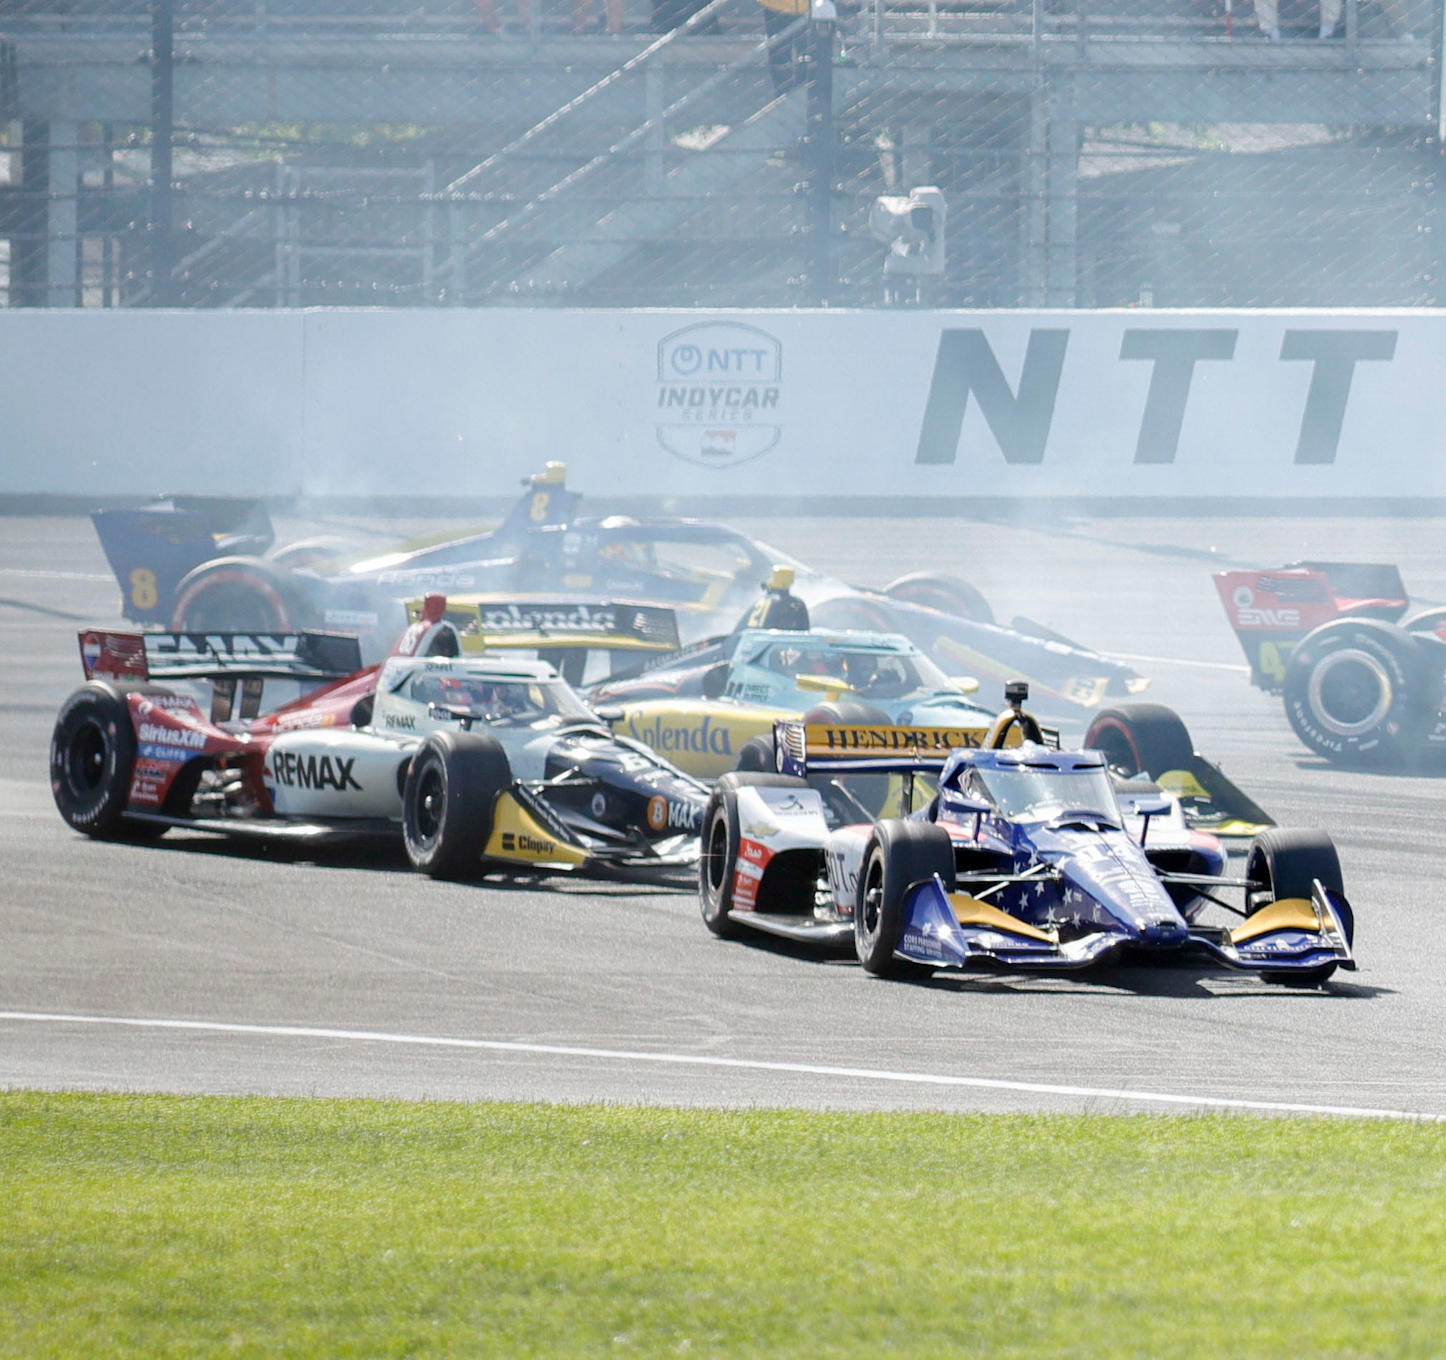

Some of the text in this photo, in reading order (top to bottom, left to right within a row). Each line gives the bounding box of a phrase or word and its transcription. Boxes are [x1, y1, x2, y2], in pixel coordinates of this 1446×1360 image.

[707, 349, 768, 372] NTT
[657, 387, 780, 409] INDYCAR
[915, 327, 1399, 465] NTT
[530, 492, 550, 523] 8
[130, 567, 158, 610] 8
[747, 597, 771, 629] 21
[138, 722, 208, 750] SiriusXM
[627, 708, 734, 758] Splenda
[826, 728, 982, 749] HENDRICK
[272, 750, 363, 791] REMAX
